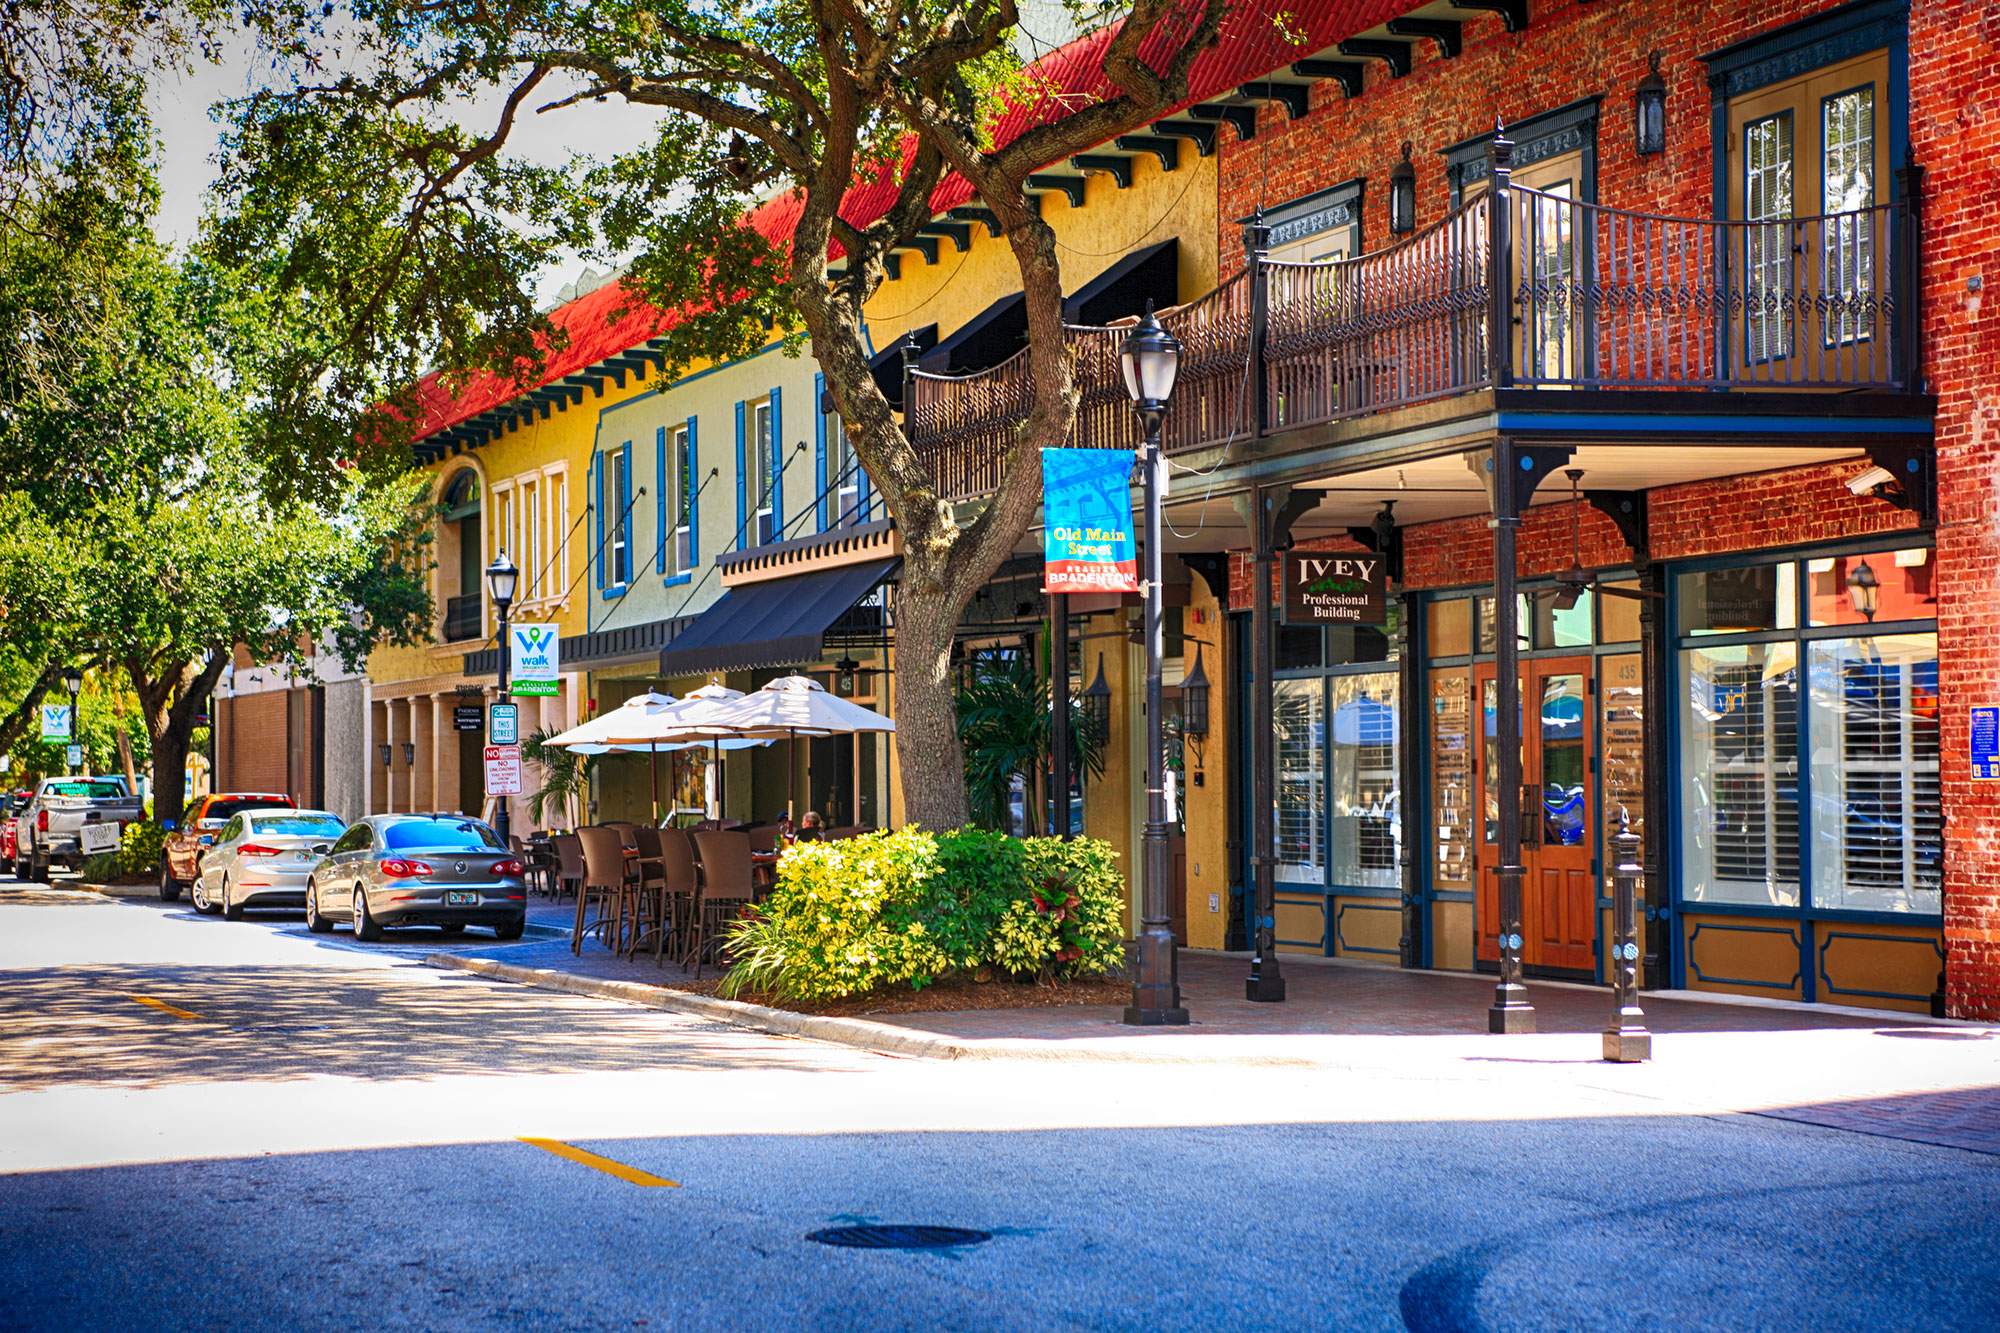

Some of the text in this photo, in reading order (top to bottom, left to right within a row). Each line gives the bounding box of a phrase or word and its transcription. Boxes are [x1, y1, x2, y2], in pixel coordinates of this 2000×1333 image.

[1053, 528, 1126, 541] Old Main
[1068, 543, 1113, 556] Street
[1066, 565, 1117, 573] REALIZE
[1297, 559, 1377, 585] IVEY
[1048, 573, 1134, 585] BRADENTON
[1302, 593, 1368, 606] Professional
[1313, 606, 1361, 621] Building
[521, 655, 549, 666] walk
[1618, 665, 1636, 679] 435
[494, 708, 500, 716] 2
[498, 720, 510, 729] THIS
[494, 729, 513, 738] STREET
[486, 749, 499, 759] NO
